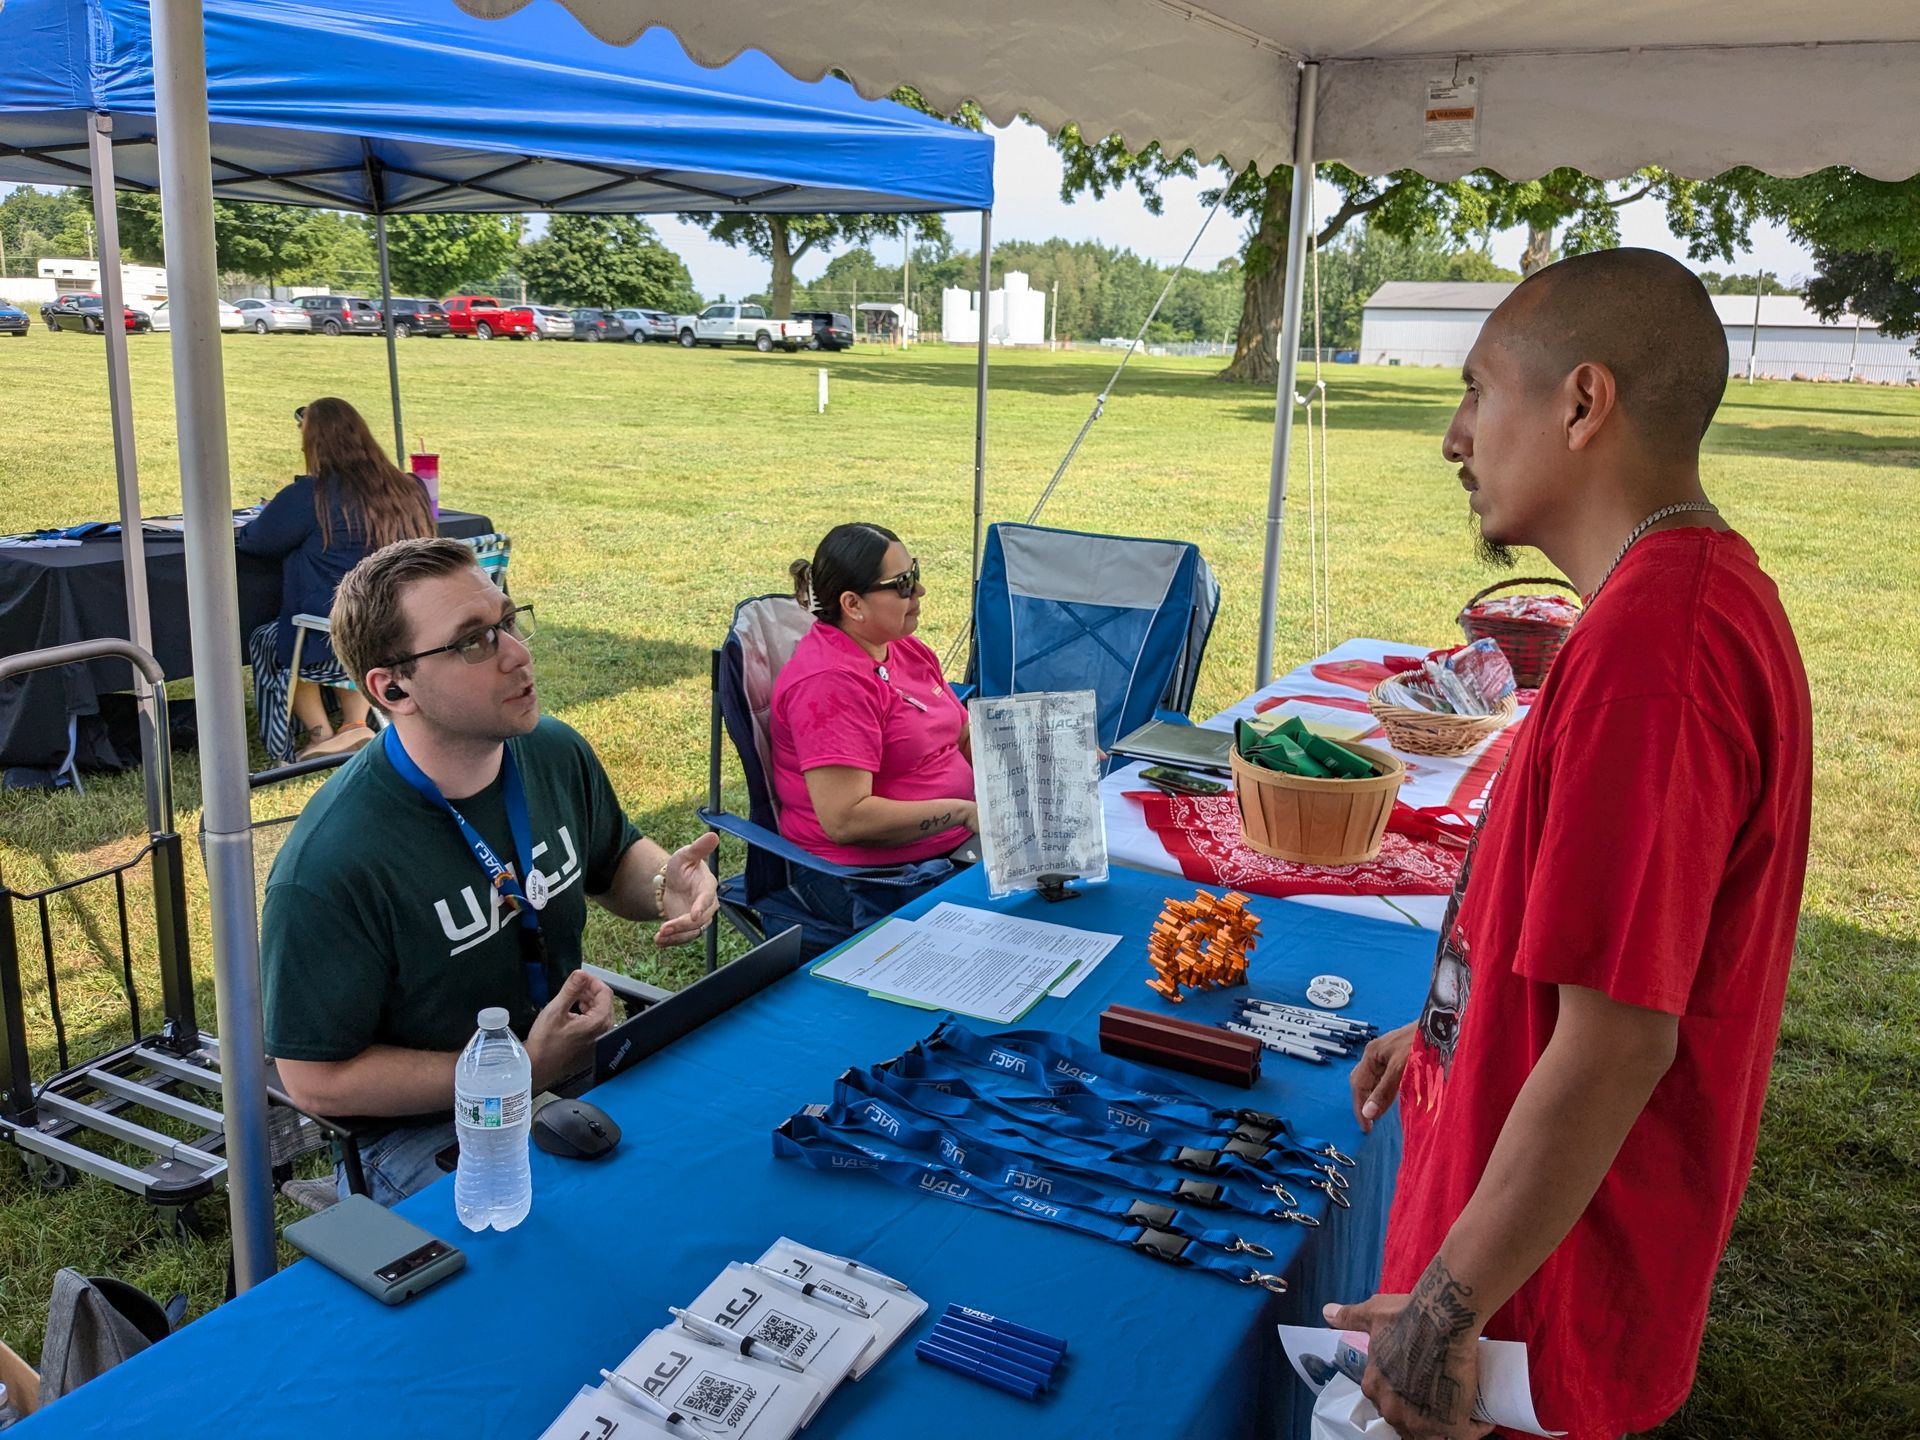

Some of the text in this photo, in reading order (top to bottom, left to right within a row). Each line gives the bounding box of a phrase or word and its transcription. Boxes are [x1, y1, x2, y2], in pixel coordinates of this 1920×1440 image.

[608, 1037, 632, 1071] ThinkPad
[989, 1049, 1028, 1074] UACJ
[1055, 1059, 1098, 1085] UACJ
[864, 1103, 901, 1137] UACJ
[1107, 1106, 1152, 1134] UACJ
[918, 1173, 970, 1200] UACJ
[1004, 1169, 1054, 1196] UACJ
[1012, 1195, 1061, 1217] UACJ
[714, 1287, 763, 1329] ACJ
[961, 1306, 995, 1323] UACJ
[642, 1351, 693, 1399] ACJ
